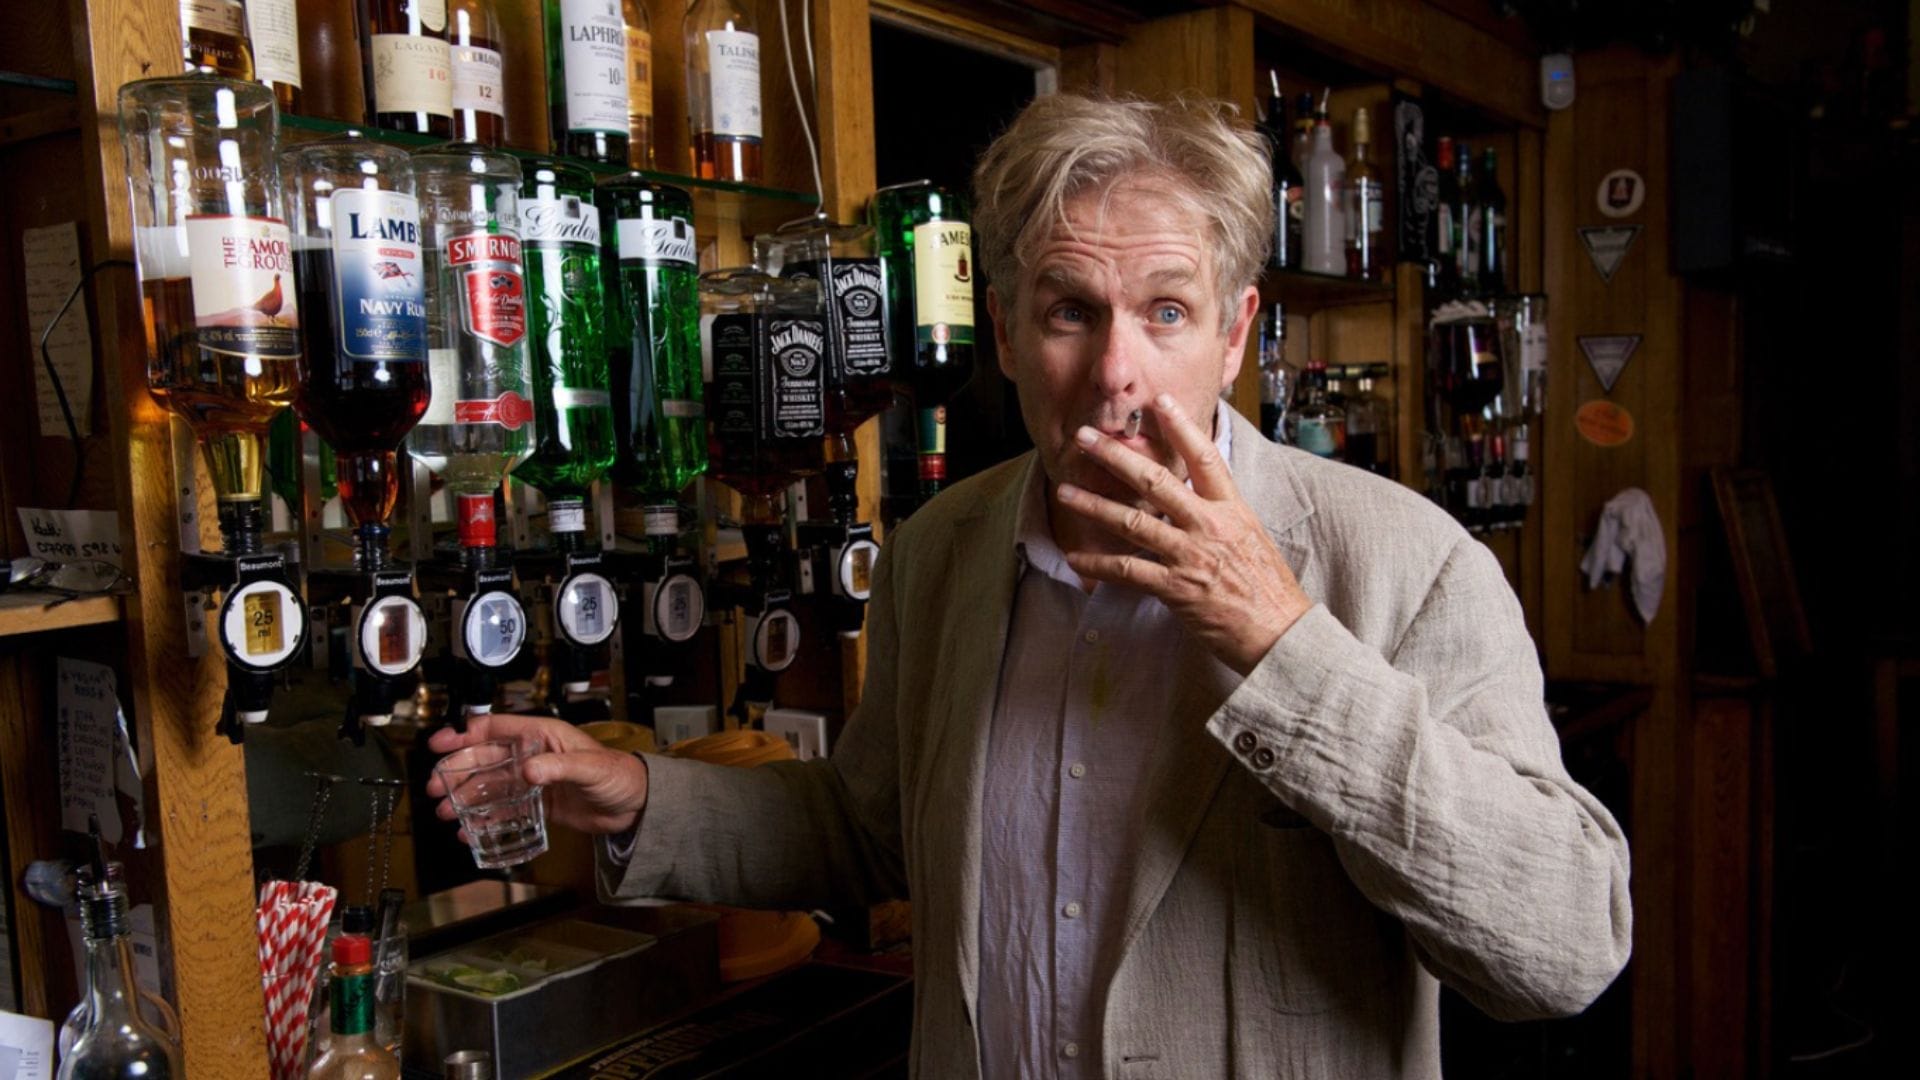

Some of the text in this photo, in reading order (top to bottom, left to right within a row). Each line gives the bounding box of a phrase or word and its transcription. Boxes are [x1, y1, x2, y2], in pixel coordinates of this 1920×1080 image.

[570, 25, 624, 46] LAPHRO
[394, 41, 446, 53] LAGAV
[718, 45, 757, 57] TALIS
[608, 67, 621, 86] 10
[478, 85, 492, 98] 12
[525, 205, 597, 239] Gordon
[239, 237, 290, 257] AMOU
[930, 230, 970, 249] AMES
[222, 236, 237, 268] THE
[453, 239, 520, 260] SMRNO
[360, 299, 402, 315] NAVY
[240, 560, 282, 572] Beaumont
[376, 577, 411, 586] Beaumont
[479, 573, 512, 583] Beaumont
[582, 597, 598, 611] 25
[253, 610, 274, 627] 25
[500, 618, 516, 634] 50
